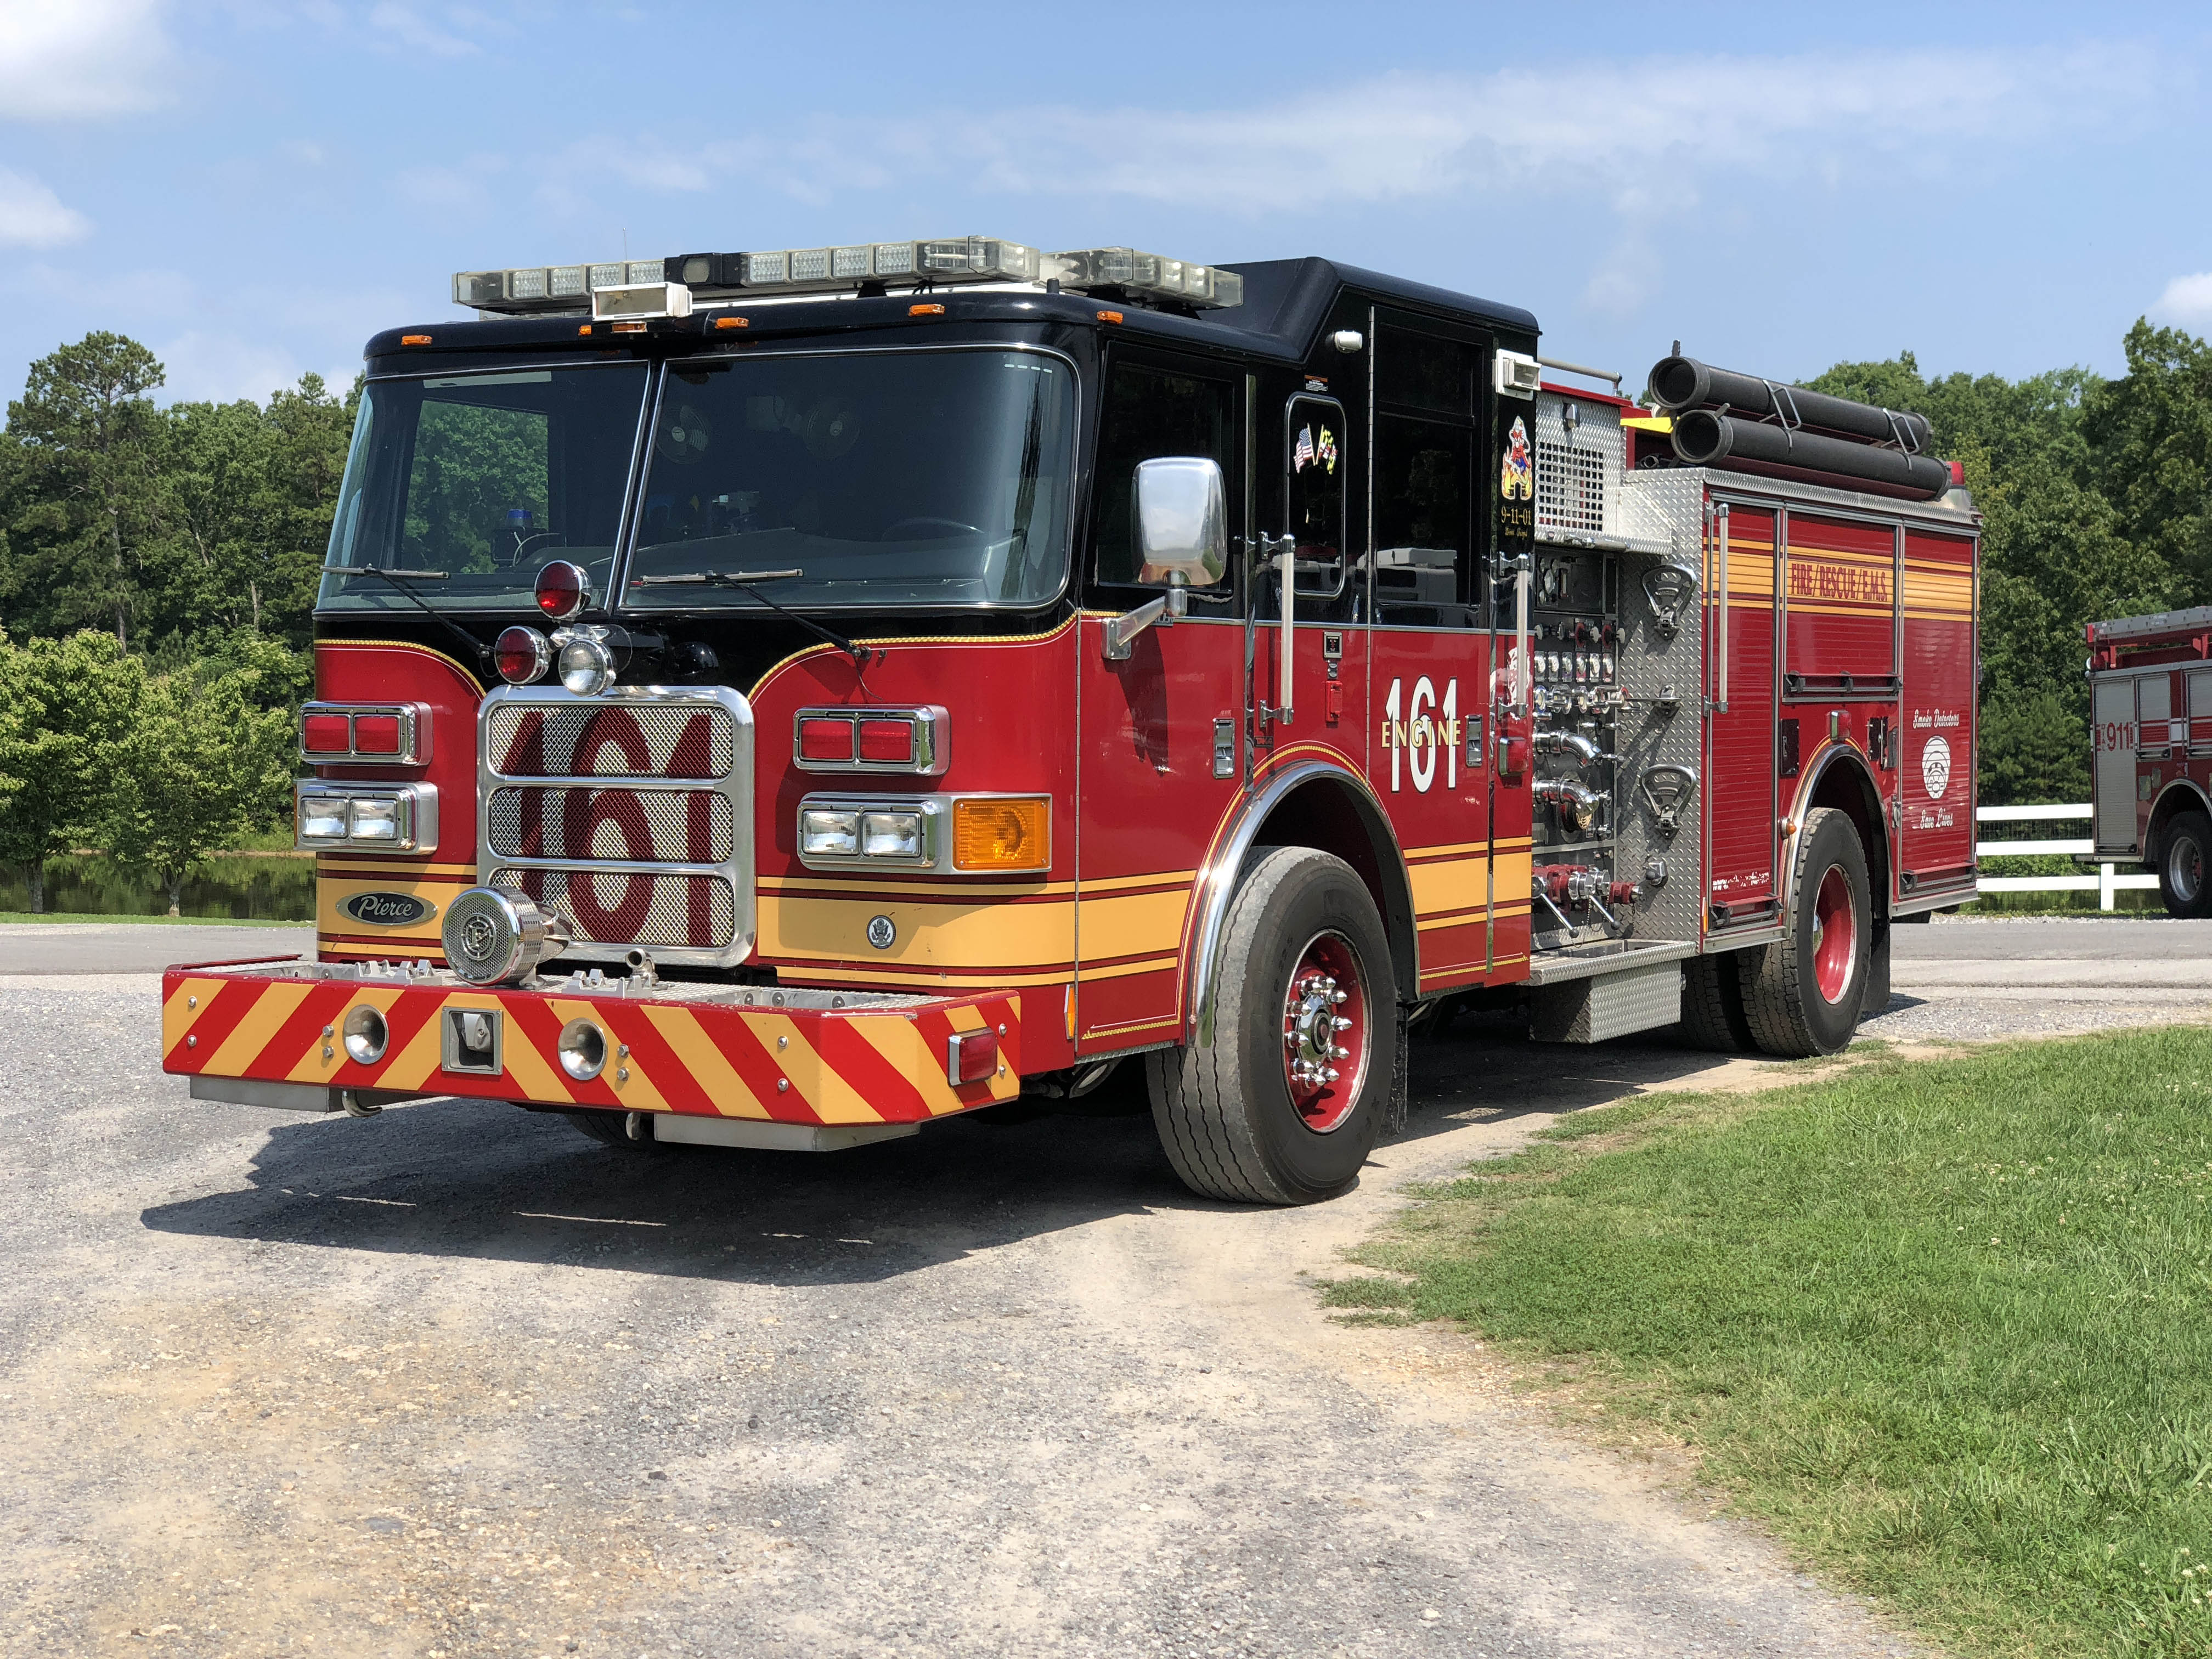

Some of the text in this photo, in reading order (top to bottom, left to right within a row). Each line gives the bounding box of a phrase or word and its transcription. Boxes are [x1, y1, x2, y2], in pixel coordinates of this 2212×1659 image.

[1501, 506, 1532, 526] 9-11-01
[1912, 708, 1960, 729] Smoke Detectors
[1381, 719, 1461, 749] ENGINE
[1385, 674, 1458, 793] 161
[2107, 722, 2130, 752] 911
[501, 704, 712, 947] 161
[1920, 807, 1953, 830] Save Lives
[357, 895, 413, 918] Pierce
